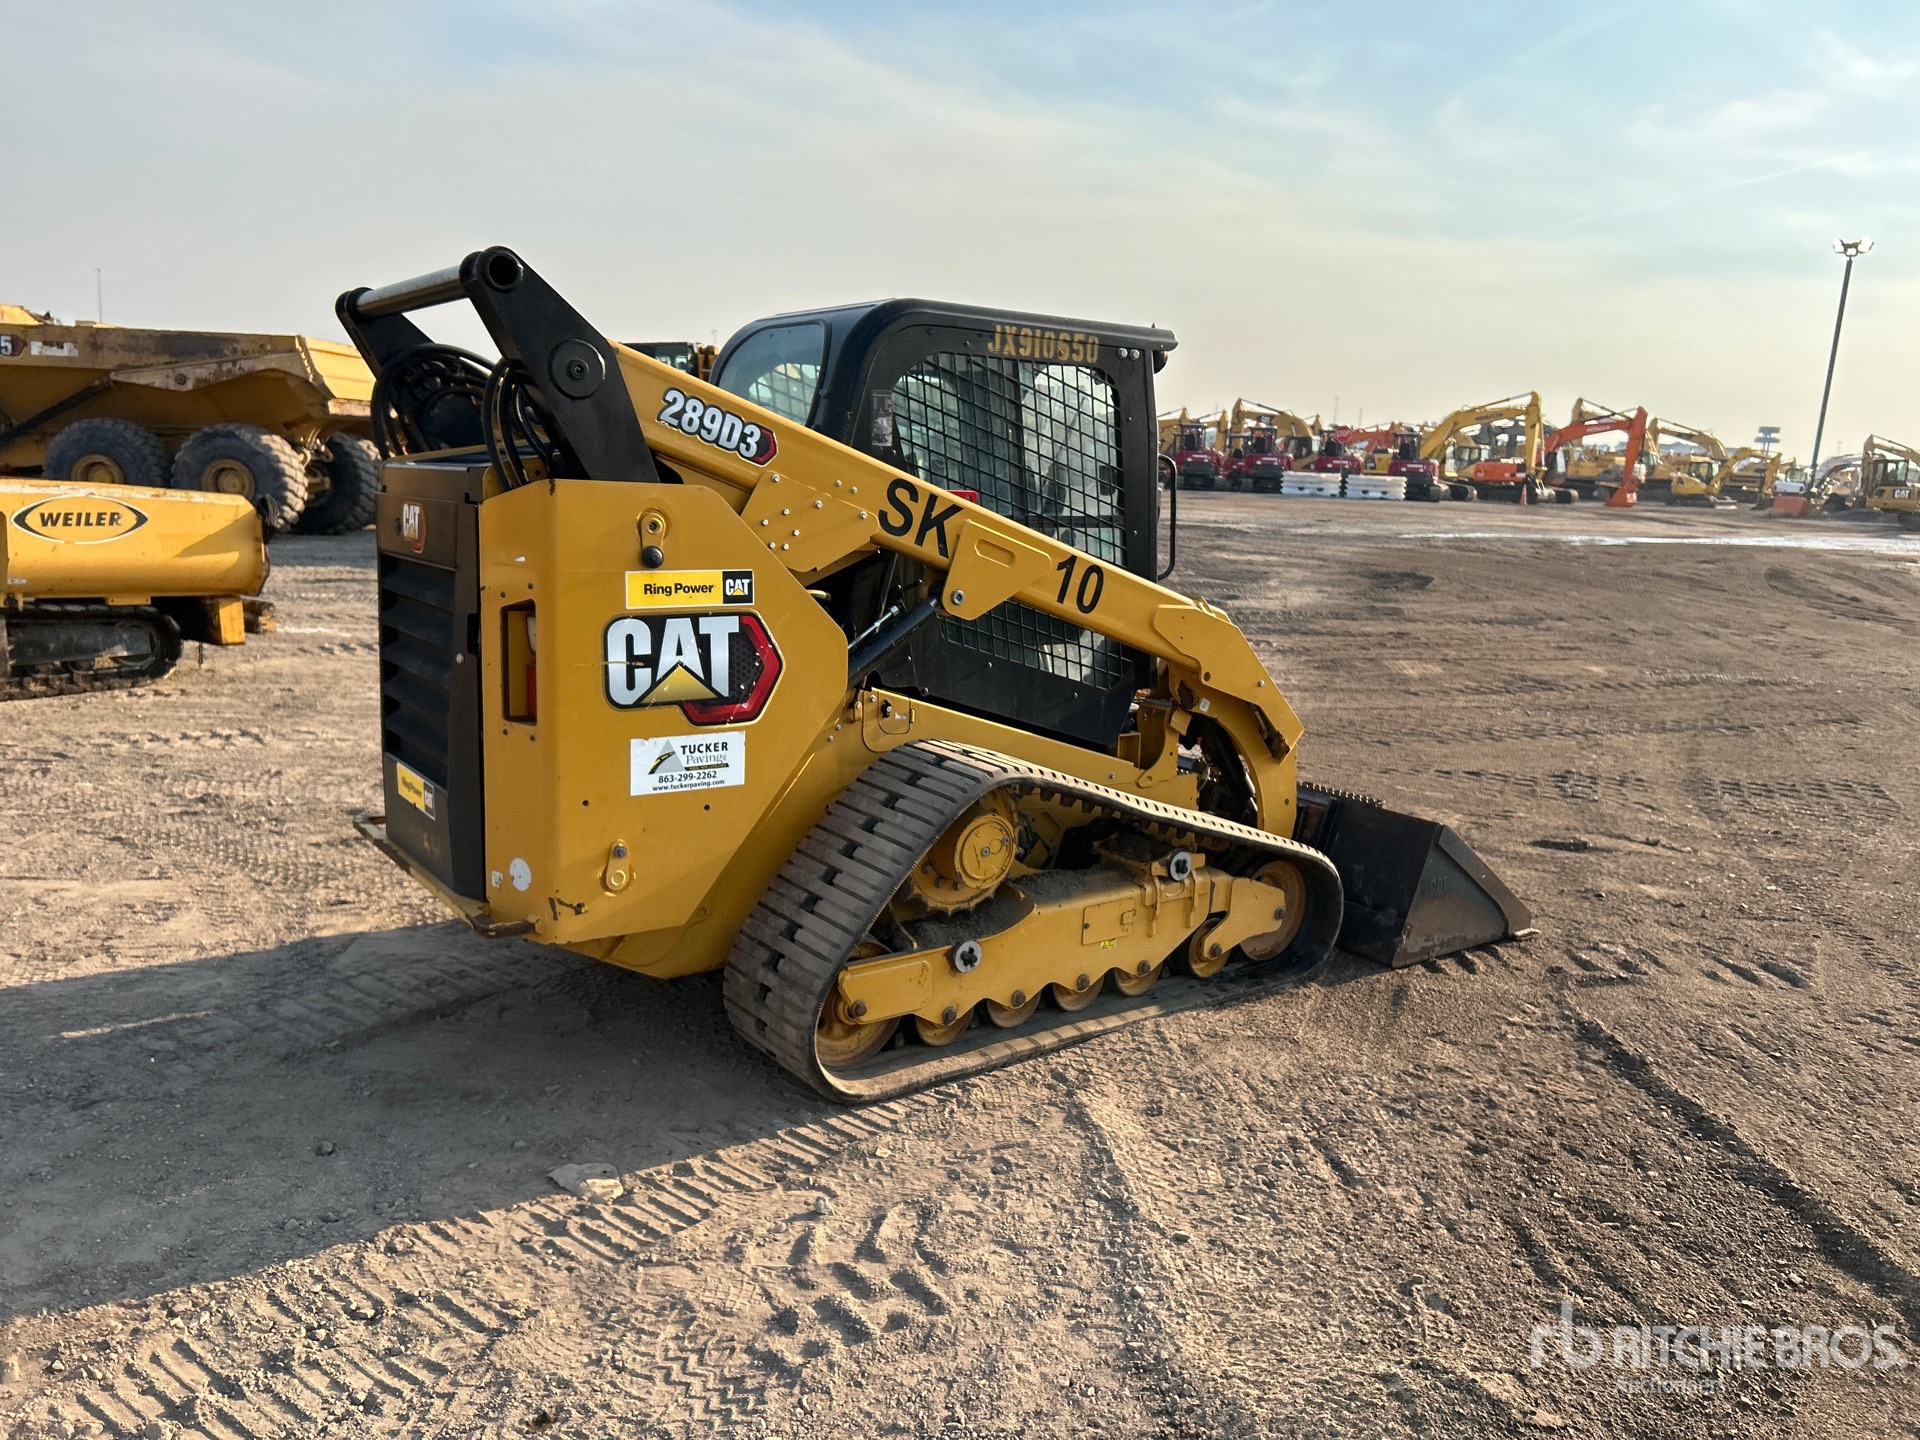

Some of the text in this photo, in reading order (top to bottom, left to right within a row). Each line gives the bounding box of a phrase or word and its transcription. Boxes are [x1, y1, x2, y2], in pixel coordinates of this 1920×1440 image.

[660, 389, 761, 458] 289D3
[1894, 489, 1910, 499] CAT
[40, 511, 122, 527] WEILER
[403, 503, 420, 540] CAT
[878, 478, 1104, 614] SK 10
[643, 578, 750, 597] Ring Power CAT
[607, 615, 740, 706] CAT
[681, 741, 729, 755] TUCKER
[686, 752, 724, 766] Paving
[658, 770, 717, 784] 863-299-2262
[652, 779, 725, 792] www.tuckerpaving.com
